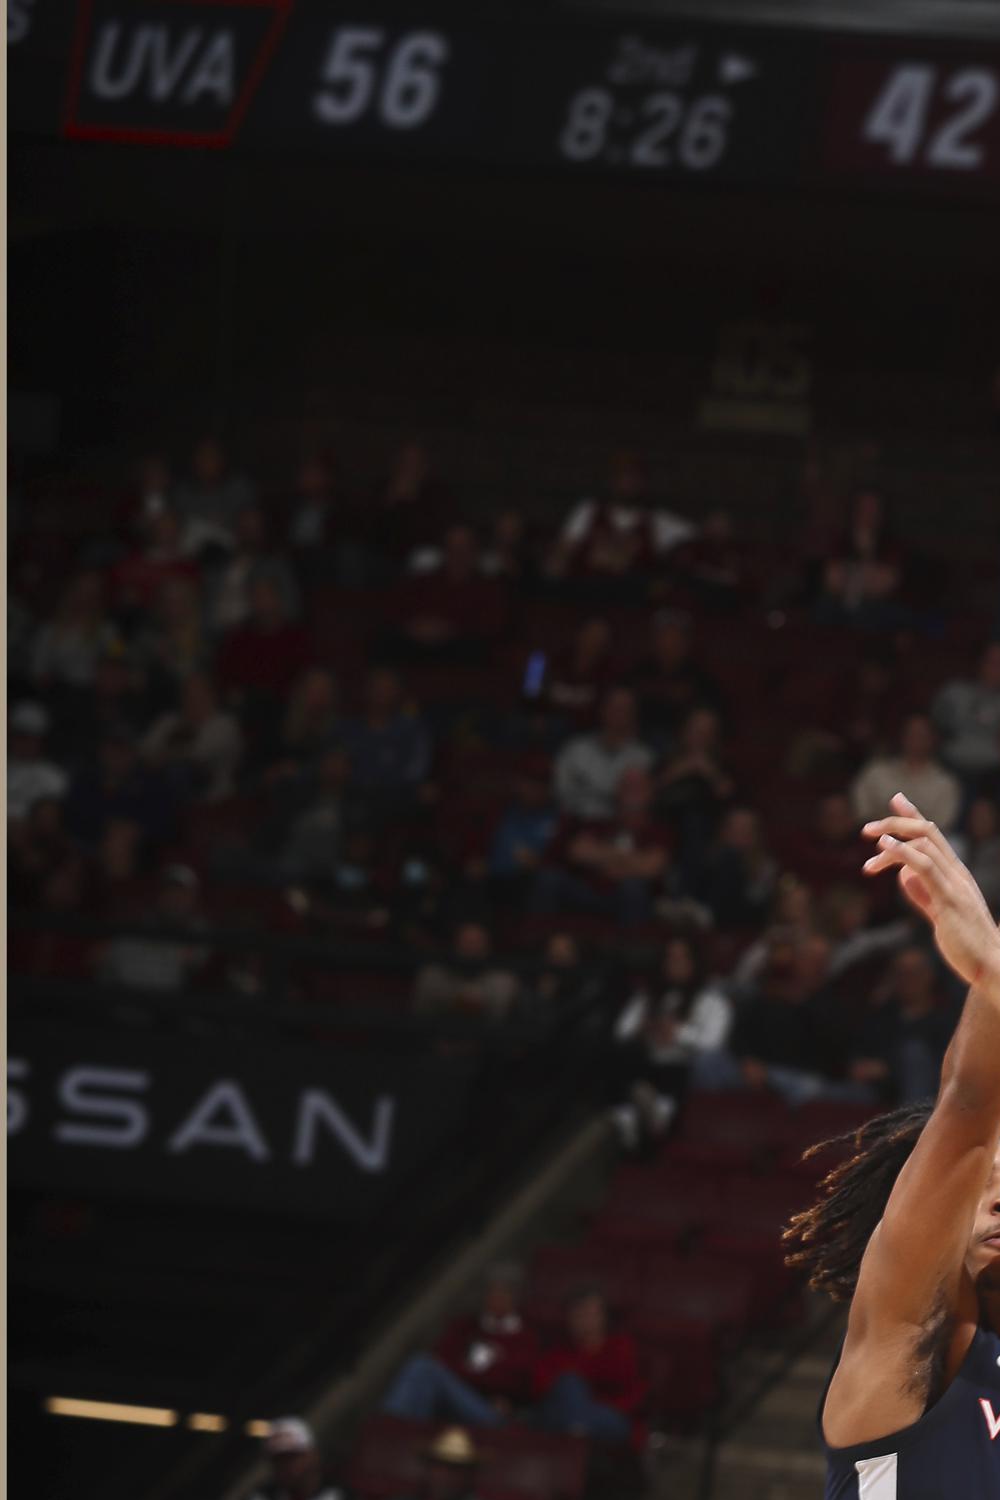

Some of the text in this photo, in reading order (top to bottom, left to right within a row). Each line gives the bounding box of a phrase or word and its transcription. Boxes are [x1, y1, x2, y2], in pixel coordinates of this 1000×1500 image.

[90, 24, 238, 104] UVA
[316, 26, 450, 128] 56
[608, 36, 698, 86] 2nd
[560, 88, 732, 169] 8:26
[864, 62, 998, 169] 42
[7, 1058, 395, 1173] SAN
